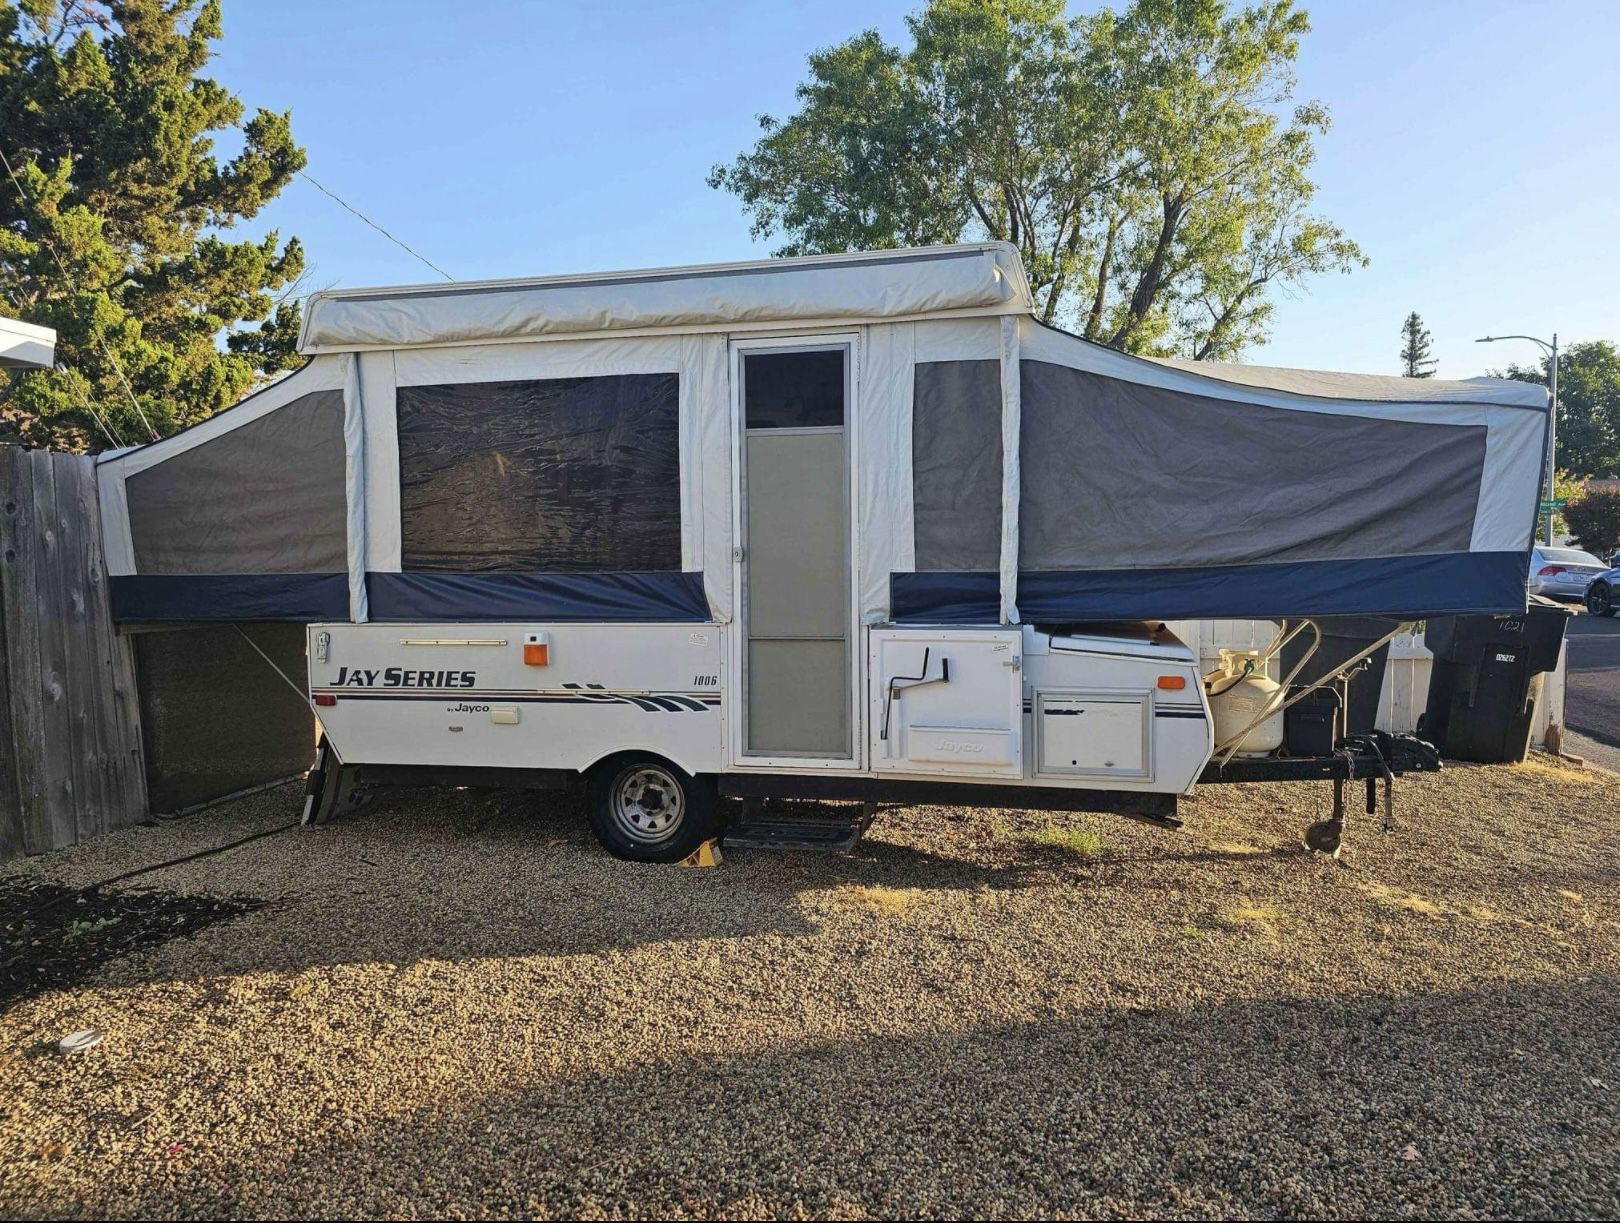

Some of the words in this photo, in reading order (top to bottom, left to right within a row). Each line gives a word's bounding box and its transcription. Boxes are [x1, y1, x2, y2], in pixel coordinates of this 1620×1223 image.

[330, 667, 380, 687] JAY
[383, 667, 476, 688] SERIES
[455, 703, 490, 714] Jayco
